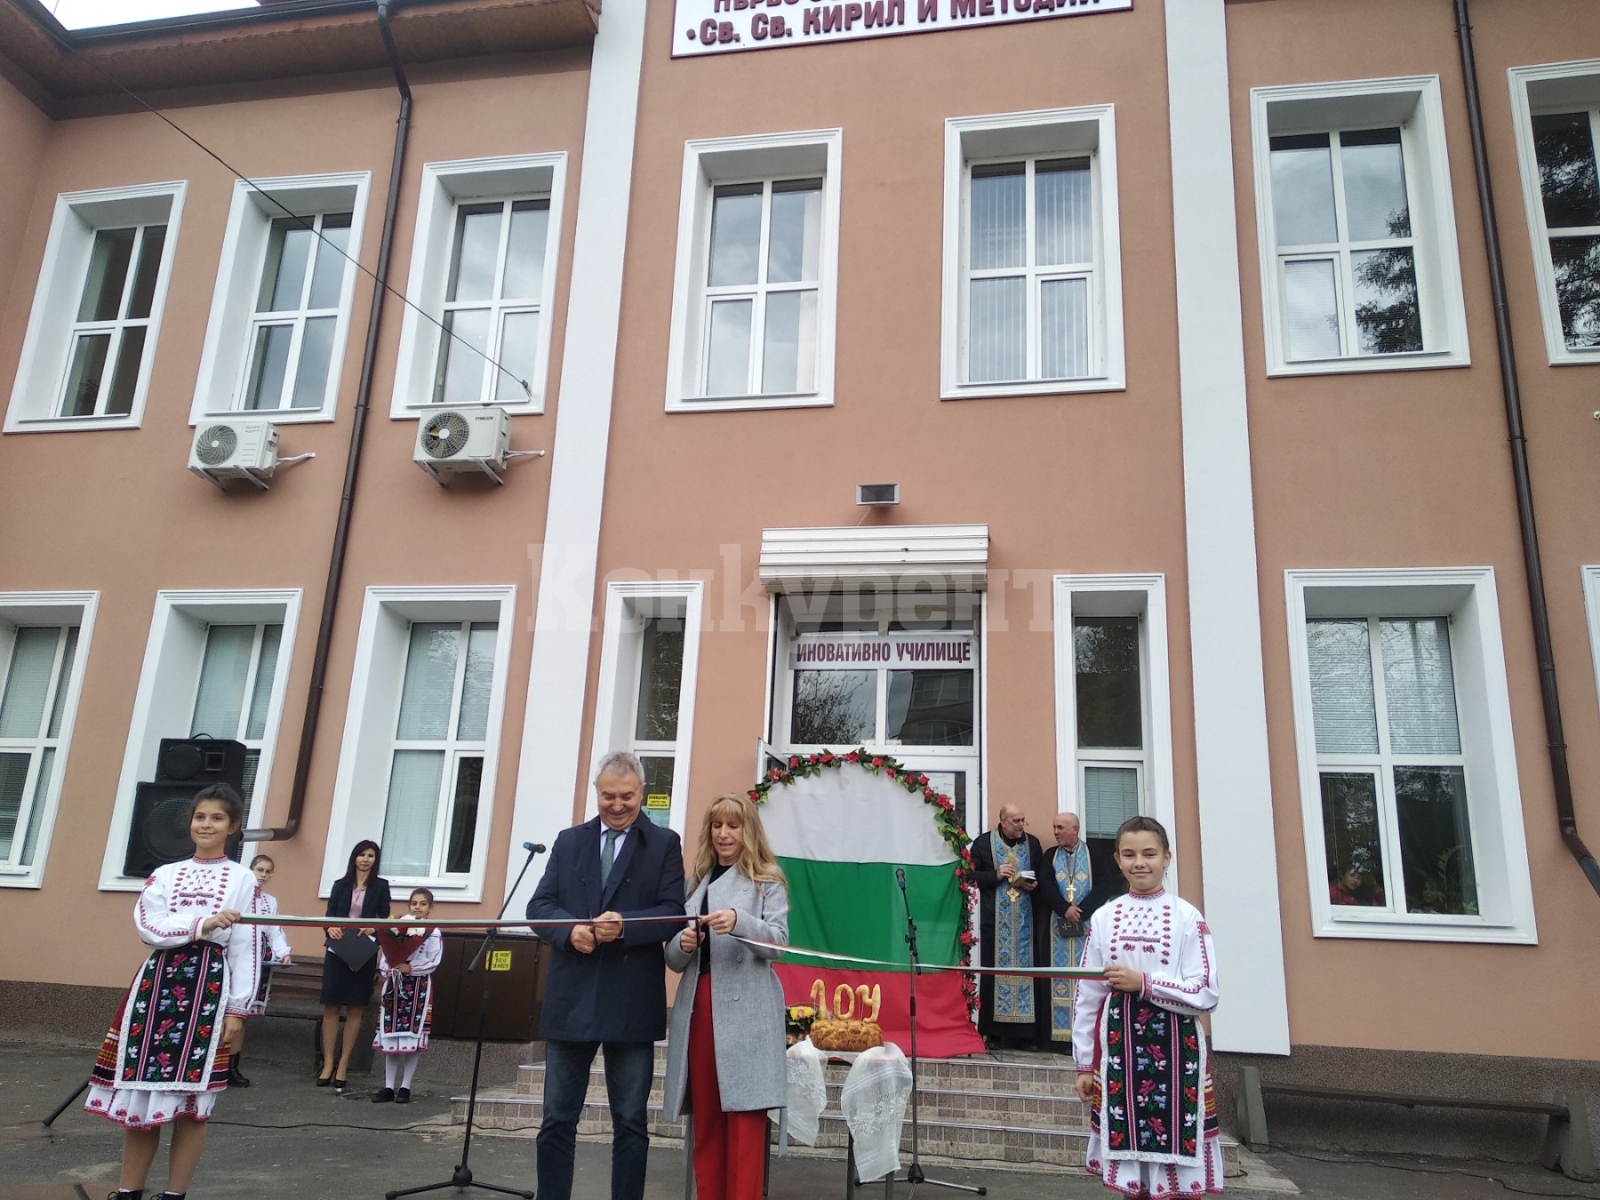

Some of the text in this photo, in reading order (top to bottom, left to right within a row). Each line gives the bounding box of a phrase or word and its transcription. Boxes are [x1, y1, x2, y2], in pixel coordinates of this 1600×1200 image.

[803, 0, 905, 35] КИРИЛ
[796, 642, 971, 663] ИНОВАТИВНО УЧИЛИЩЕ
